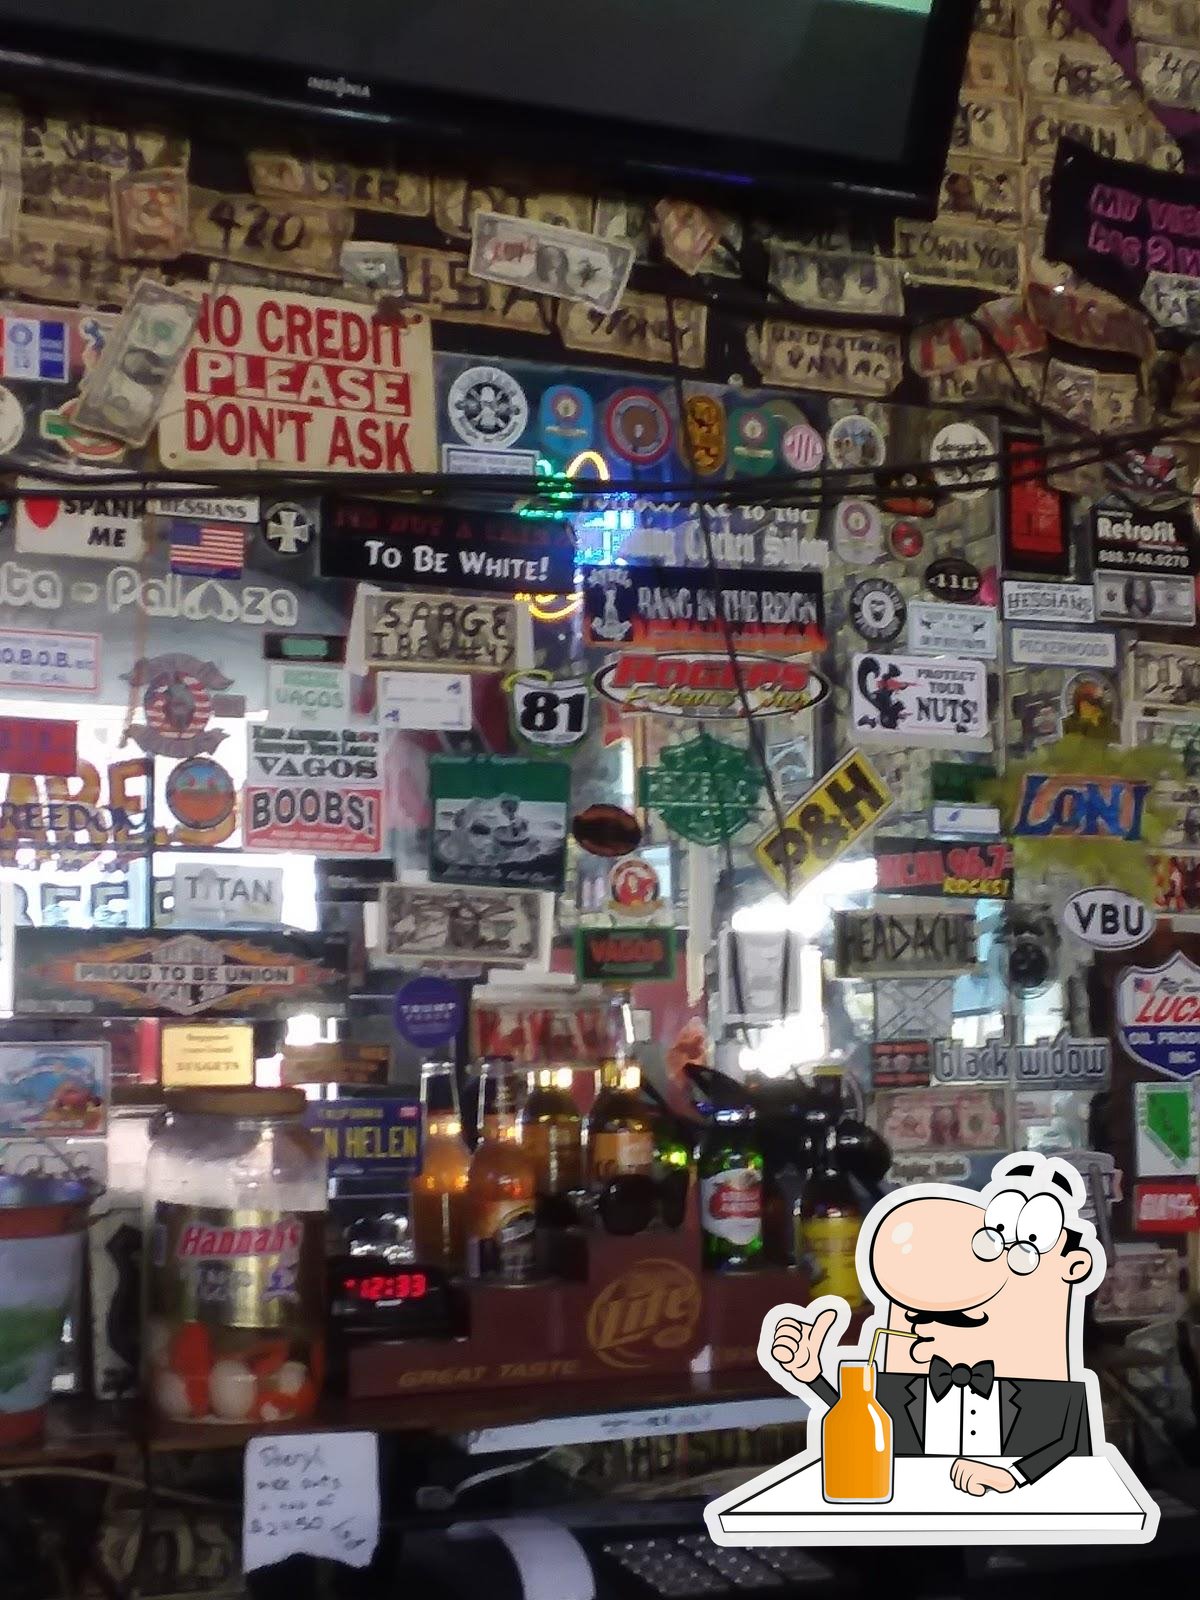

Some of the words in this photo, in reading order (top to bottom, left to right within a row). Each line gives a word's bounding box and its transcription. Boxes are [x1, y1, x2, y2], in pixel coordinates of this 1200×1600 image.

[208, 200, 304, 251] 420
[919, 233, 967, 263] OWN
[974, 243, 1018, 268] YOU
[257, 301, 402, 367] CREDIT
[198, 352, 406, 414] PLEASE
[186, 402, 313, 460] DON'T
[329, 417, 412, 471] ASK
[87, 526, 126, 548] ME
[1097, 517, 1177, 543] Retrofit
[383, 598, 512, 640] SARGE
[917, 669, 976, 681] PROTECT
[520, 694, 585, 732] 81
[917, 698, 978, 724] NUTS!
[255, 756, 377, 779] VAGOS
[252, 788, 373, 835] BOOBS!
[1073, 902, 1144, 937] VBU
[80, 965, 152, 981] PROUD
[158, 966, 184, 981] TO
[191, 967, 217, 981] BE
[224, 967, 289, 983] UNION
[938, 1043, 1007, 1078] black
[1018, 1045, 1104, 1077] widow
[345, 1126, 417, 1159] HELEN
